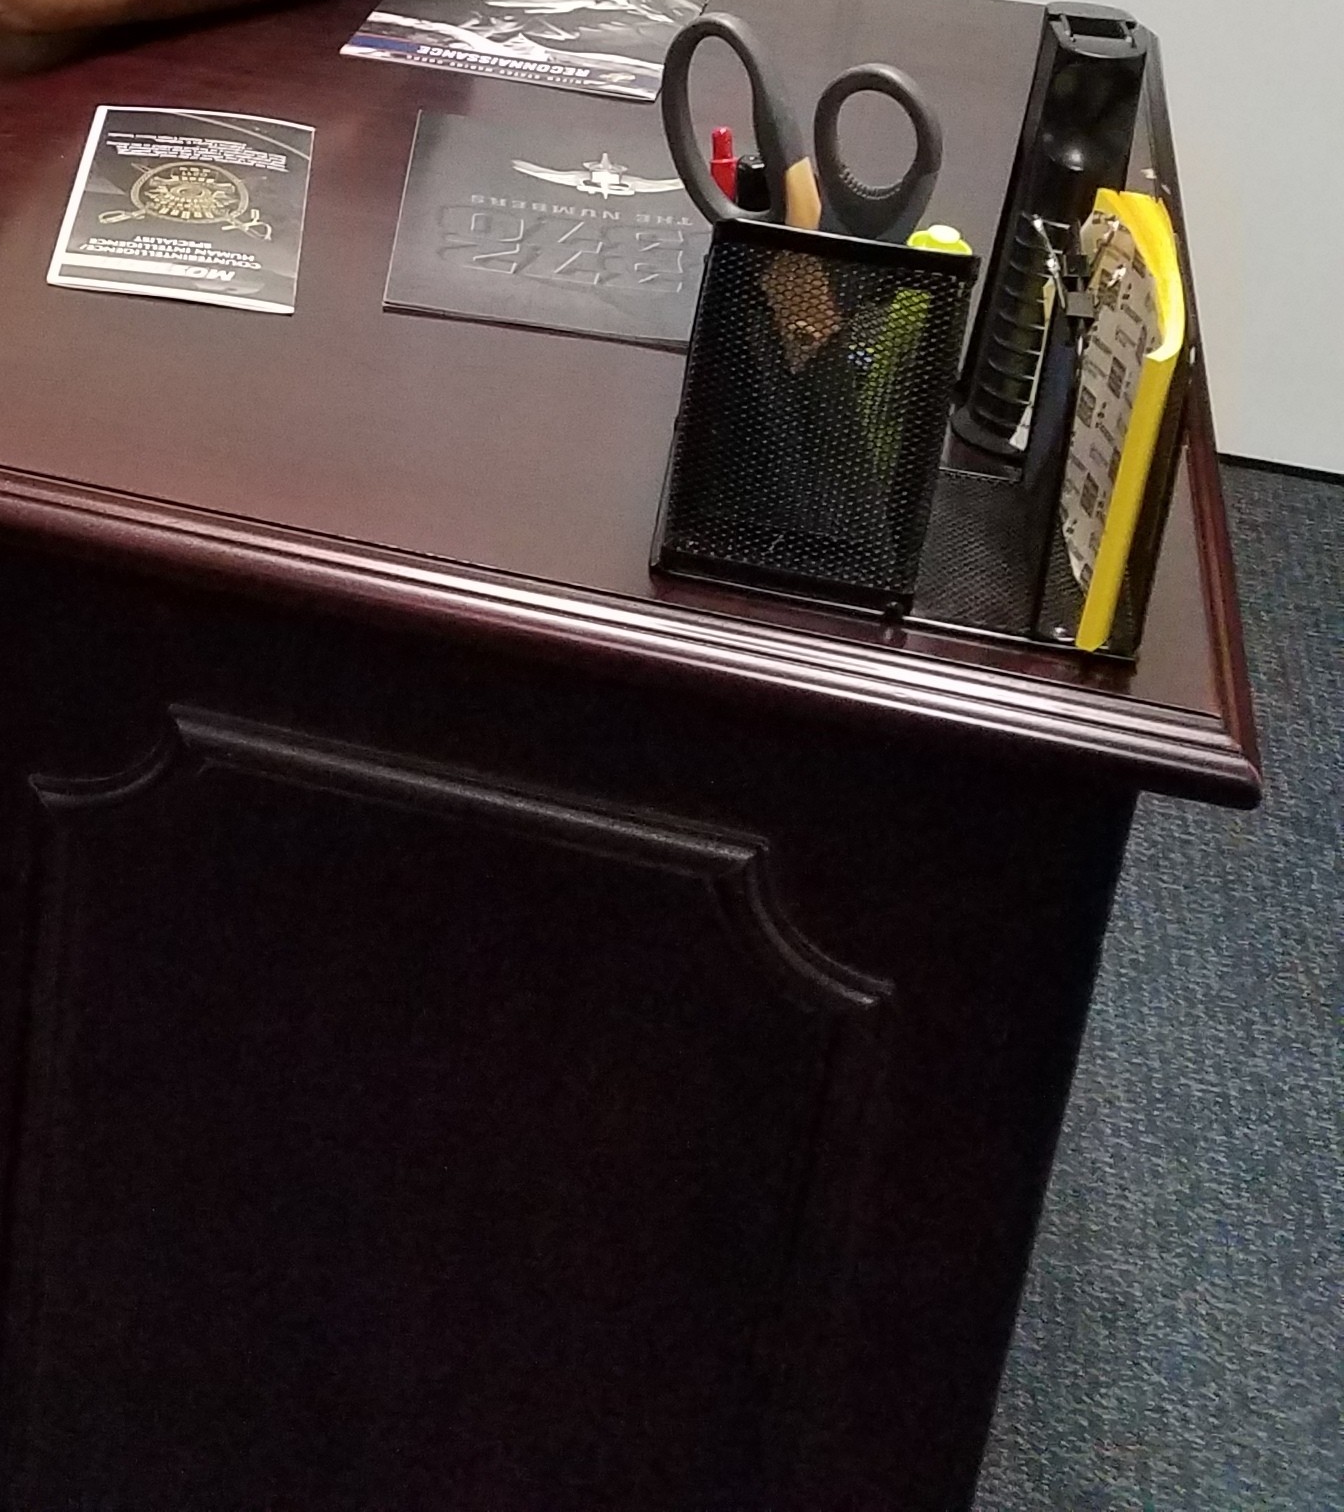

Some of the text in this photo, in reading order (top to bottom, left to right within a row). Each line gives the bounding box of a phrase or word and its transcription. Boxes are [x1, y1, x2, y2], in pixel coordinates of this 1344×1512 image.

[417, 44, 590, 78] RECONNAISSANCE
[470, 193, 694, 227] THE NUMBERS
[89, 238, 256, 263] HUMAN INTELLIGENCE
[134, 236, 212, 248] SPECIALIST
